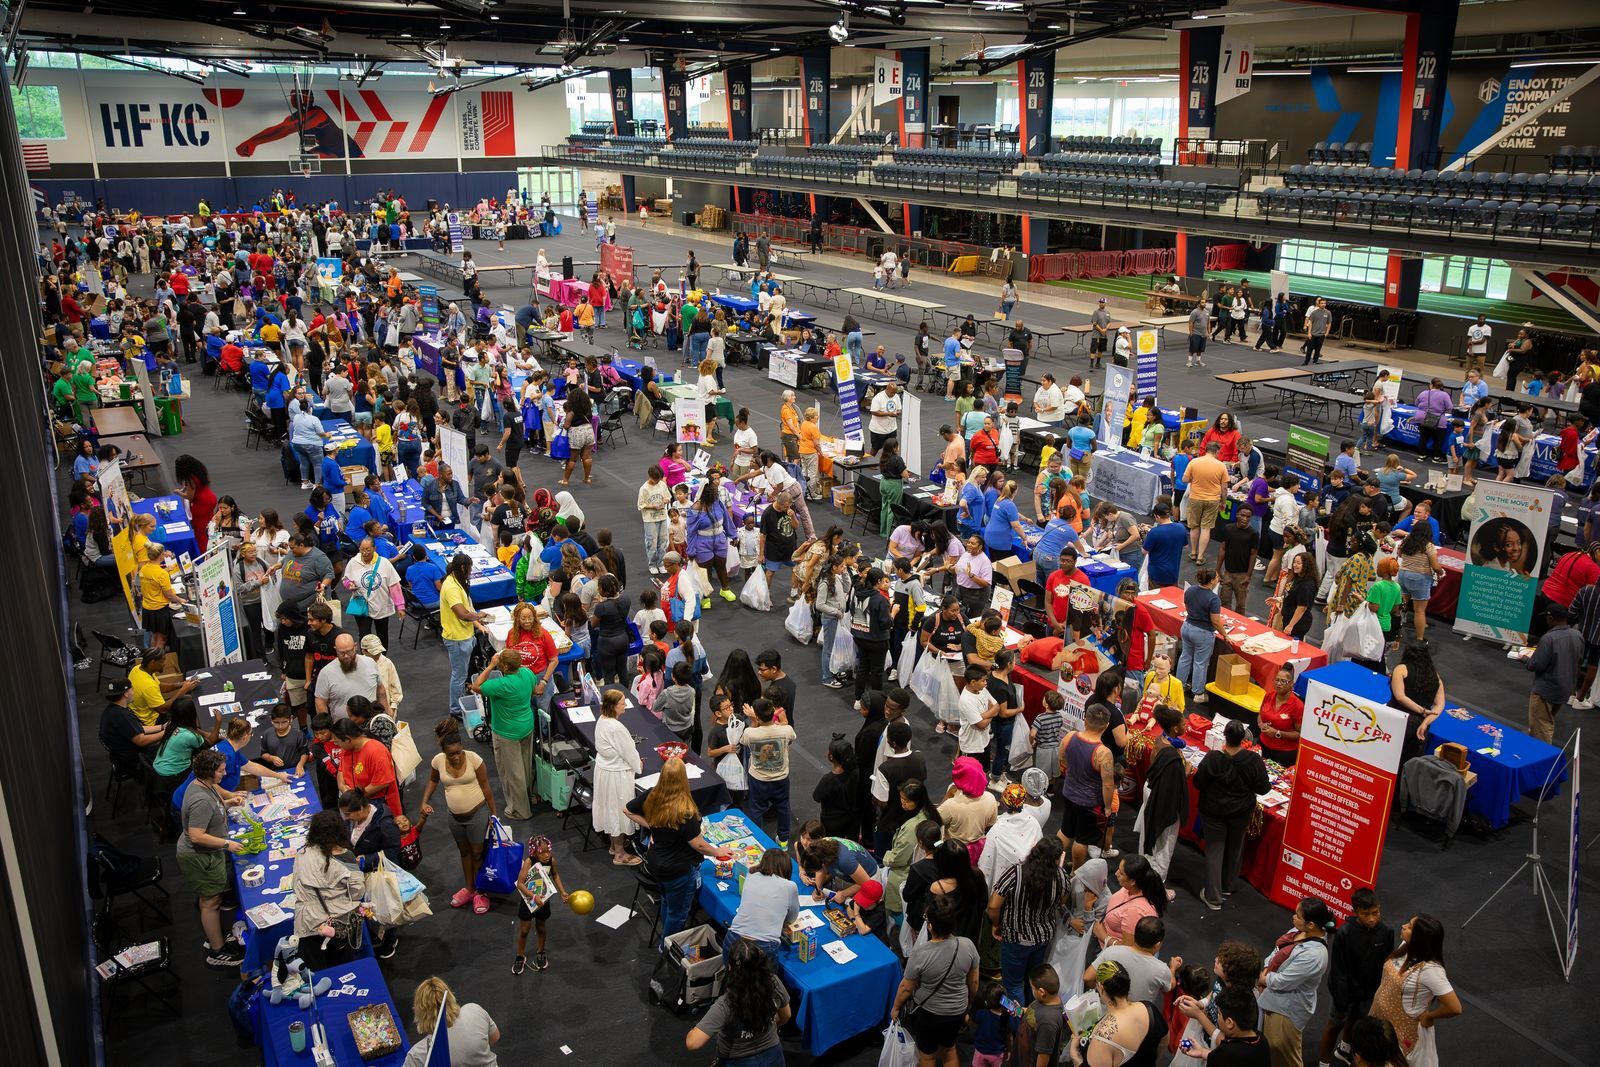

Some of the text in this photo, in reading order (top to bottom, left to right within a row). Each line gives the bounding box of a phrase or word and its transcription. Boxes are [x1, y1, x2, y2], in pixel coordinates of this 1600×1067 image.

[1223, 50, 1249, 74] 7 D
[1417, 56, 1437, 79] 212
[878, 67, 899, 84] 8 E
[1029, 71, 1045, 88] 213
[1191, 65, 1209, 84] 213
[669, 86, 681, 97] 216
[732, 83, 745, 95] 216
[810, 80, 823, 93] 215
[906, 77, 921, 91] 214
[1508, 79, 1550, 90] ENJOY
[616, 88, 627, 98] 217
[99, 103, 210, 147] HF KC
[1542, 126, 1567, 137] THE
[1498, 138, 1536, 149] GAME.
[1137, 371, 1157, 379] VENDORS
[838, 383, 856, 393] VENDORS
[1137, 386, 1157, 394] VENDORS
[840, 400, 858, 410] VENDORS
[842, 416, 861, 426] VENDORS
[1496, 496, 1509, 505] THE
[1510, 499, 1529, 508] MOVE
[1470, 571, 1529, 589] Empowering young
[1474, 580, 1498, 588] women
[1471, 585, 1493, 594] toward
[1504, 591, 1523, 600] future
[1481, 593, 1504, 603] healthy
[1471, 604, 1495, 613] focused
[1313, 707, 1392, 743] CHIEFS CPR
[1313, 754, 1374, 783] AMERICAN HEART ASSOCIATION
[1330, 769, 1353, 784] RED CROSS
[1306, 769, 1315, 777] CPR
[1337, 781, 1351, 792] EVENT
[1351, 786, 1375, 801] SPECIALIST
[1315, 786, 1360, 811] COURSES OFFERED:
[1301, 792, 1318, 802] NARCAN
[1320, 800, 1332, 808] DRUG
[1331, 804, 1352, 817] OVERDOSE
[1351, 812, 1370, 825] TRAINING
[1309, 803, 1359, 829] ACTIVE SHOOTER TRAINING
[1310, 812, 1355, 835] BABY SITTING TRAINING
[1310, 820, 1352, 842] INSTRUCTOR COURSES
[1313, 837, 1322, 845] CPR
[1314, 830, 1345, 848] STOP THE BLEED
[1311, 845, 1342, 863] BLS ACLS PALS
[1286, 875, 1302, 888] EMAIL:
[1303, 872, 1339, 894] CONTACT US AT
[1282, 884, 1303, 899] WEBSITE:
